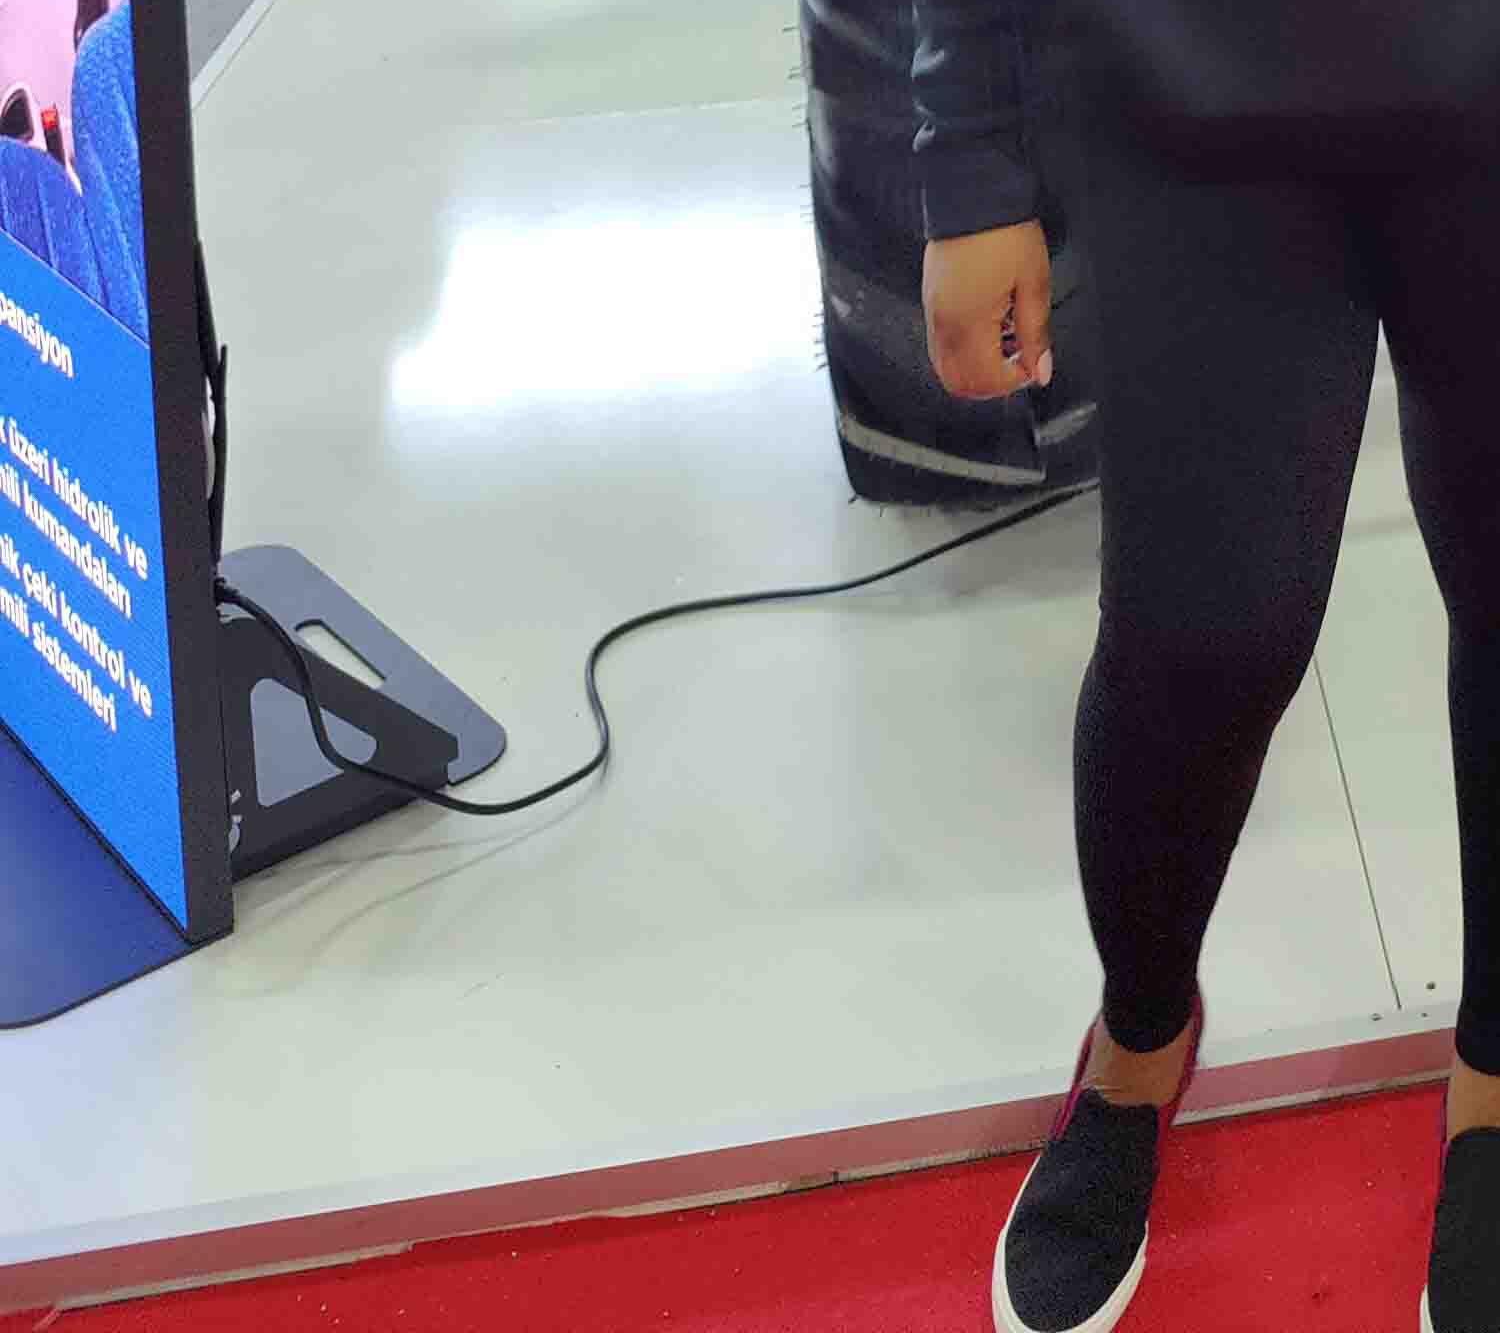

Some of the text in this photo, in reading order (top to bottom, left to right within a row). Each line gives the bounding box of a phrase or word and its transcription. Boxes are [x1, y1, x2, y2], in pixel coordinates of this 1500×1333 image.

[8, 415, 149, 582] üzeri hidrolik ve
[32, 618, 118, 735] sistemleri
[61, 589, 126, 690] kontrol
[128, 669, 154, 719] ve
